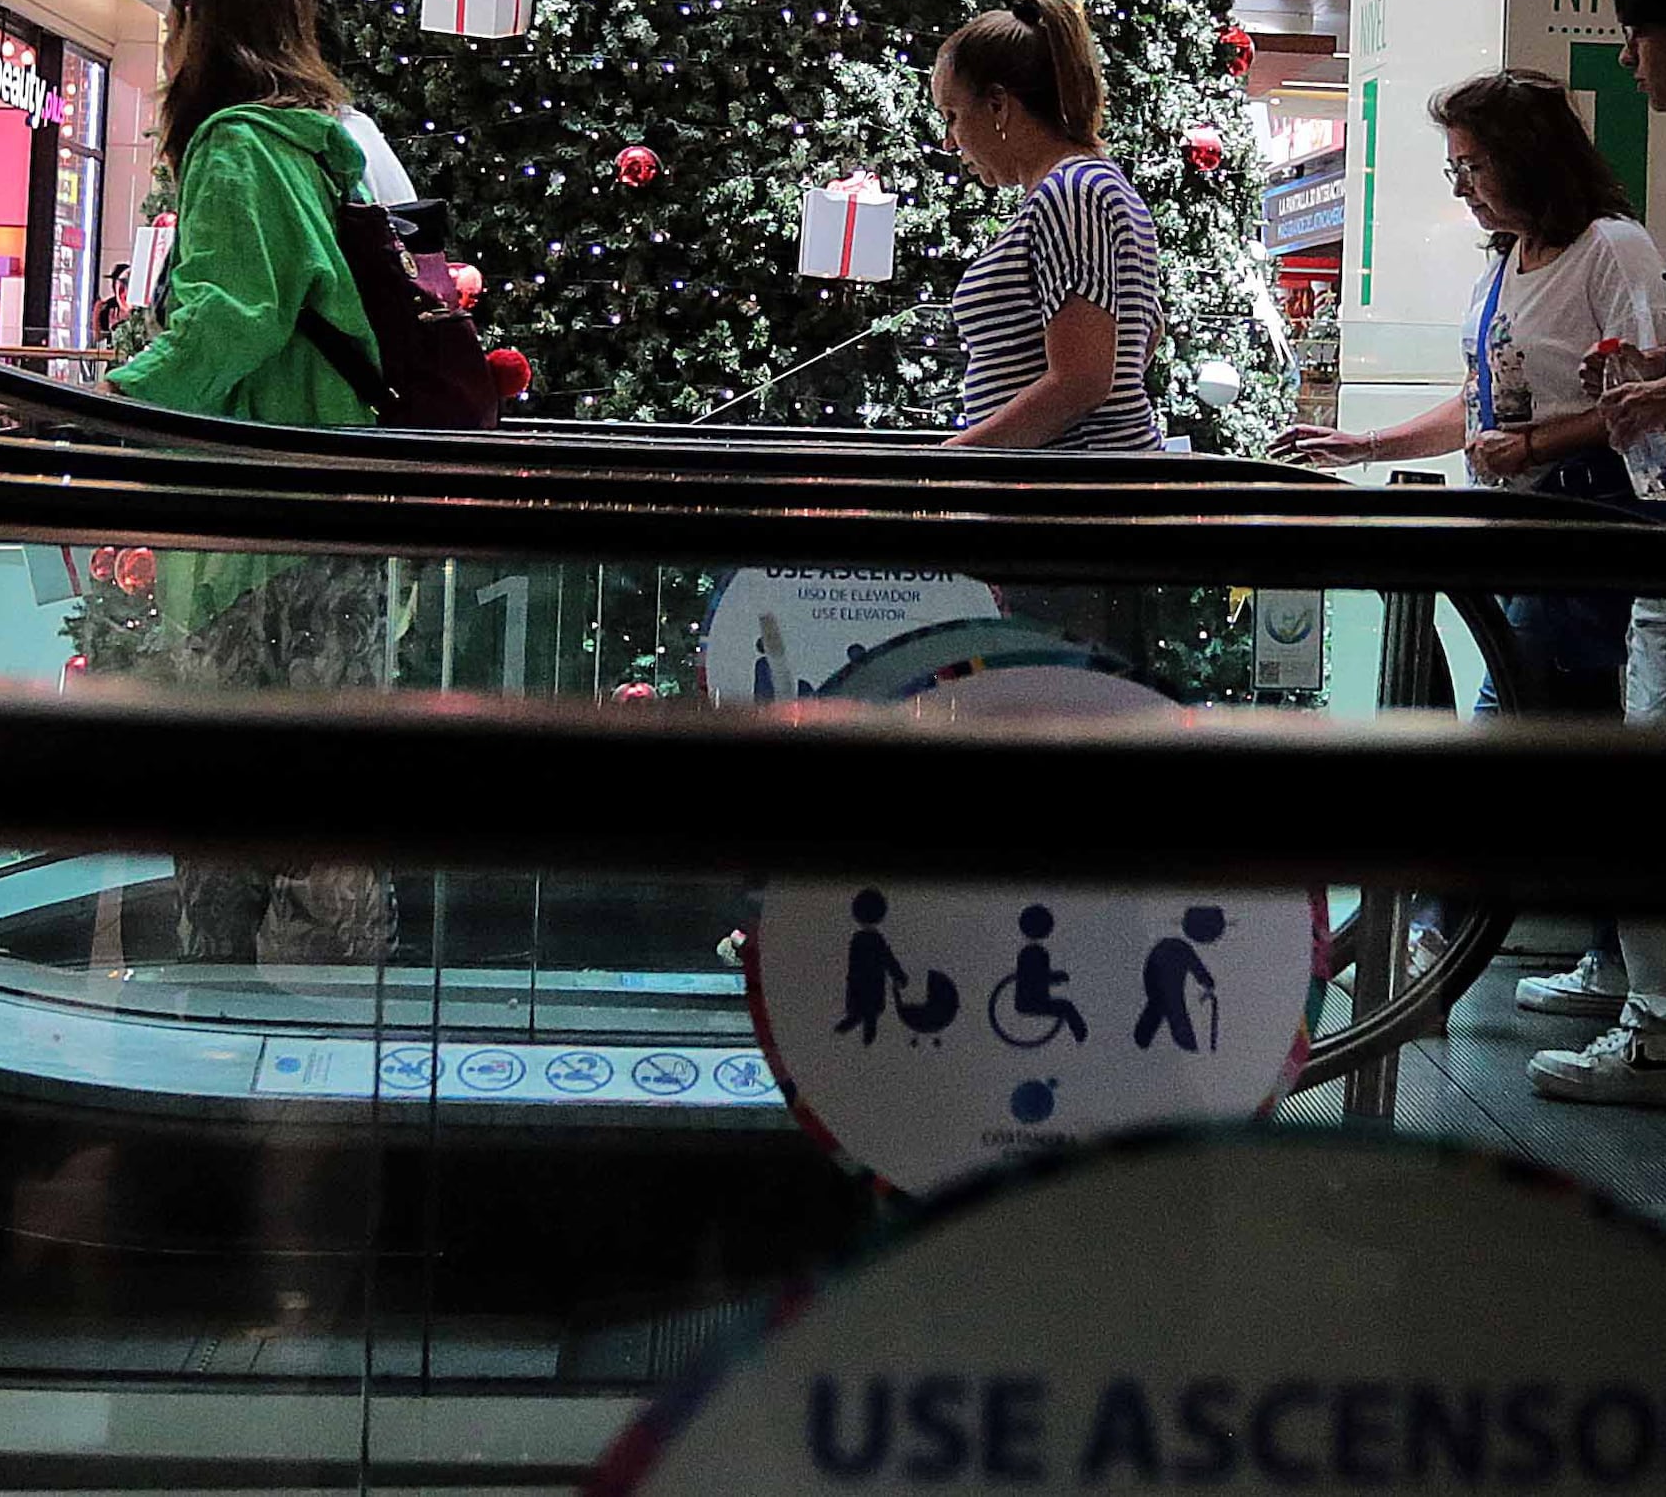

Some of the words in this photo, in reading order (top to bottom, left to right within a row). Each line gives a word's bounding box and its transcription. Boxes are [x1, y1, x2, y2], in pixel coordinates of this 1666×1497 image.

[798, 587, 826, 601] USO
[829, 588, 848, 602] DE
[850, 588, 921, 603] ELEVADOR
[812, 606, 836, 620] USE
[840, 607, 906, 622] ELEVATOR
[808, 1375, 1044, 1483] USE
